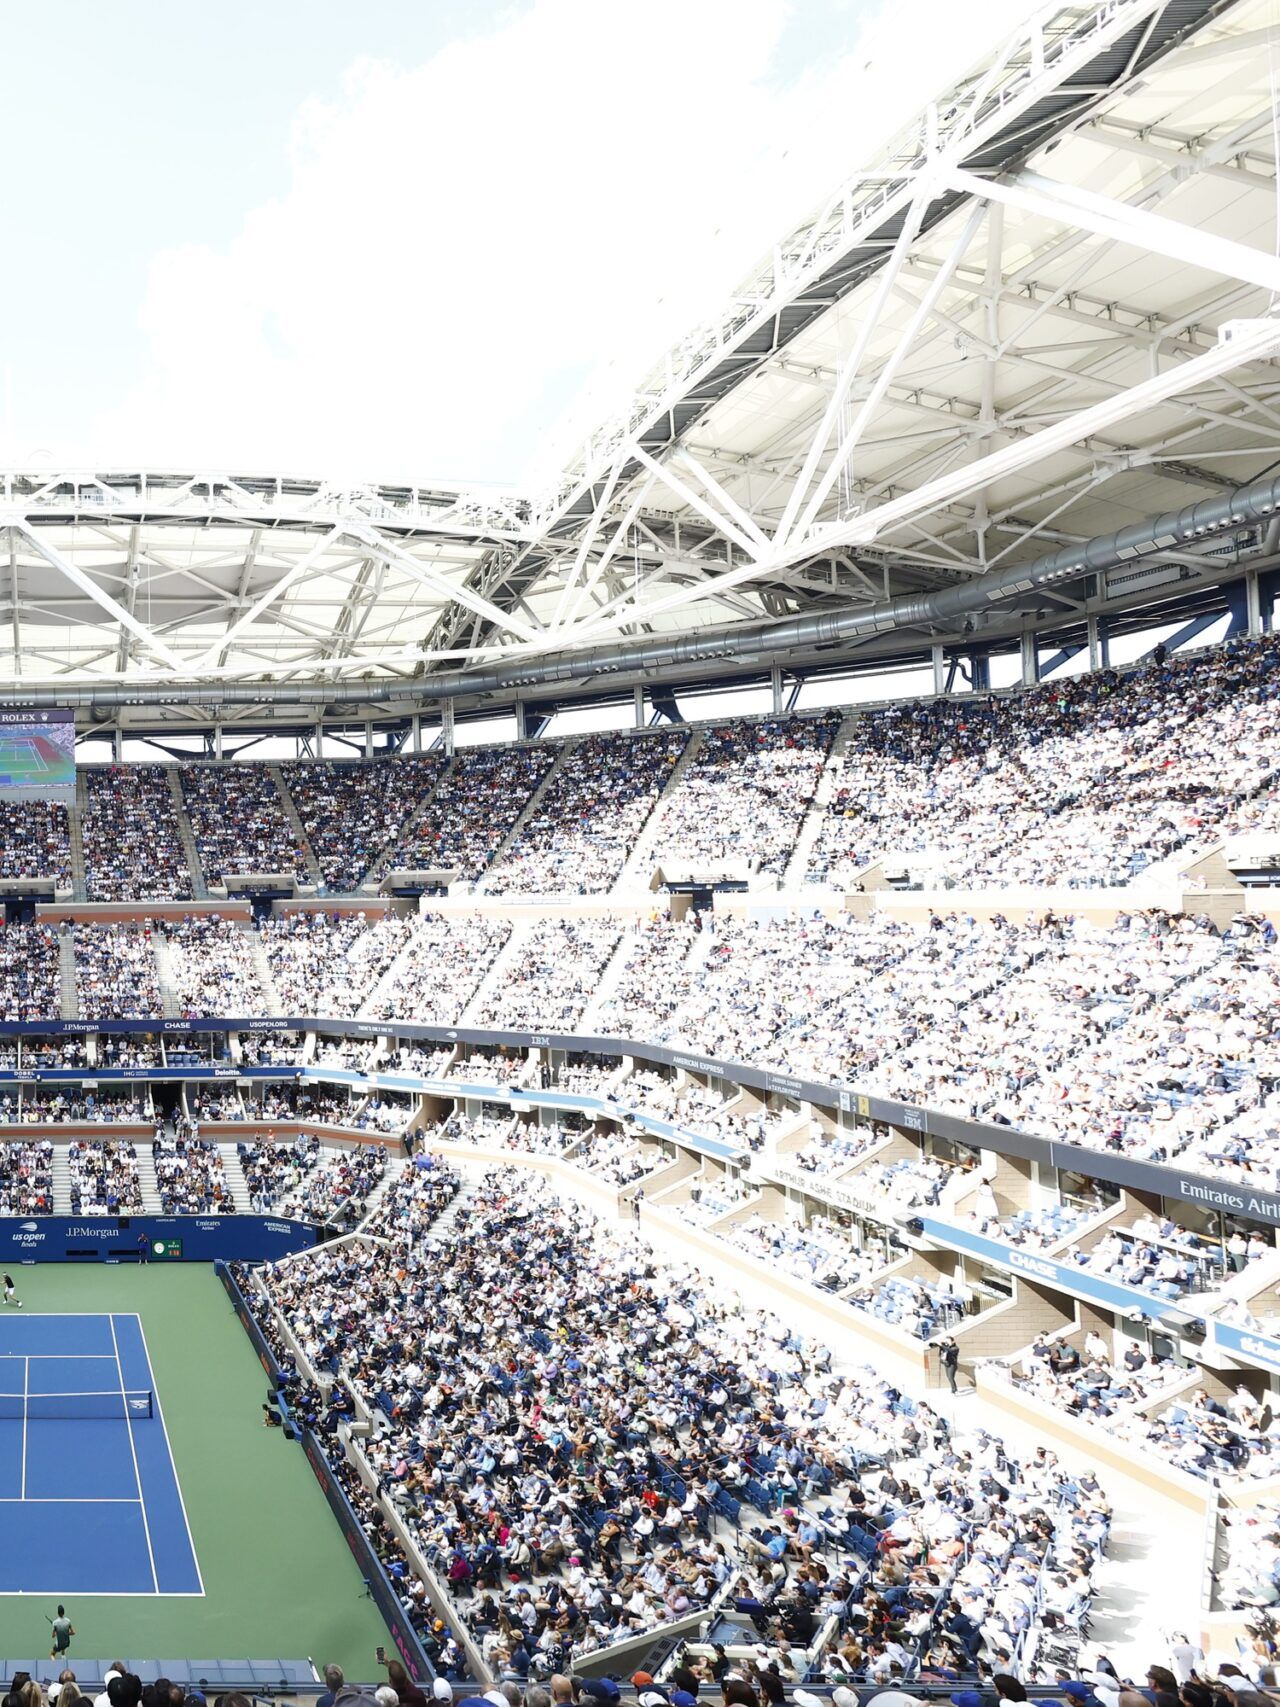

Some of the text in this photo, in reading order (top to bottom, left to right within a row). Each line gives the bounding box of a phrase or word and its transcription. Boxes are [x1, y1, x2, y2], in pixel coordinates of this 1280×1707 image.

[2, 714, 36, 722] ROLEX
[63, 1024, 100, 1032] J.P.Morgan
[531, 1036, 550, 1045] IBM
[673, 1056, 724, 1075] AMERICAN EXPRESS
[904, 1116, 922, 1129] IBM
[1180, 1180, 1244, 1209] Emirates
[835, 1191, 877, 1213] STADIUM
[23, 1233, 46, 1242] open
[65, 1227, 119, 1240] J.P.Morgan
[1009, 1251, 1058, 1281] CHASE
